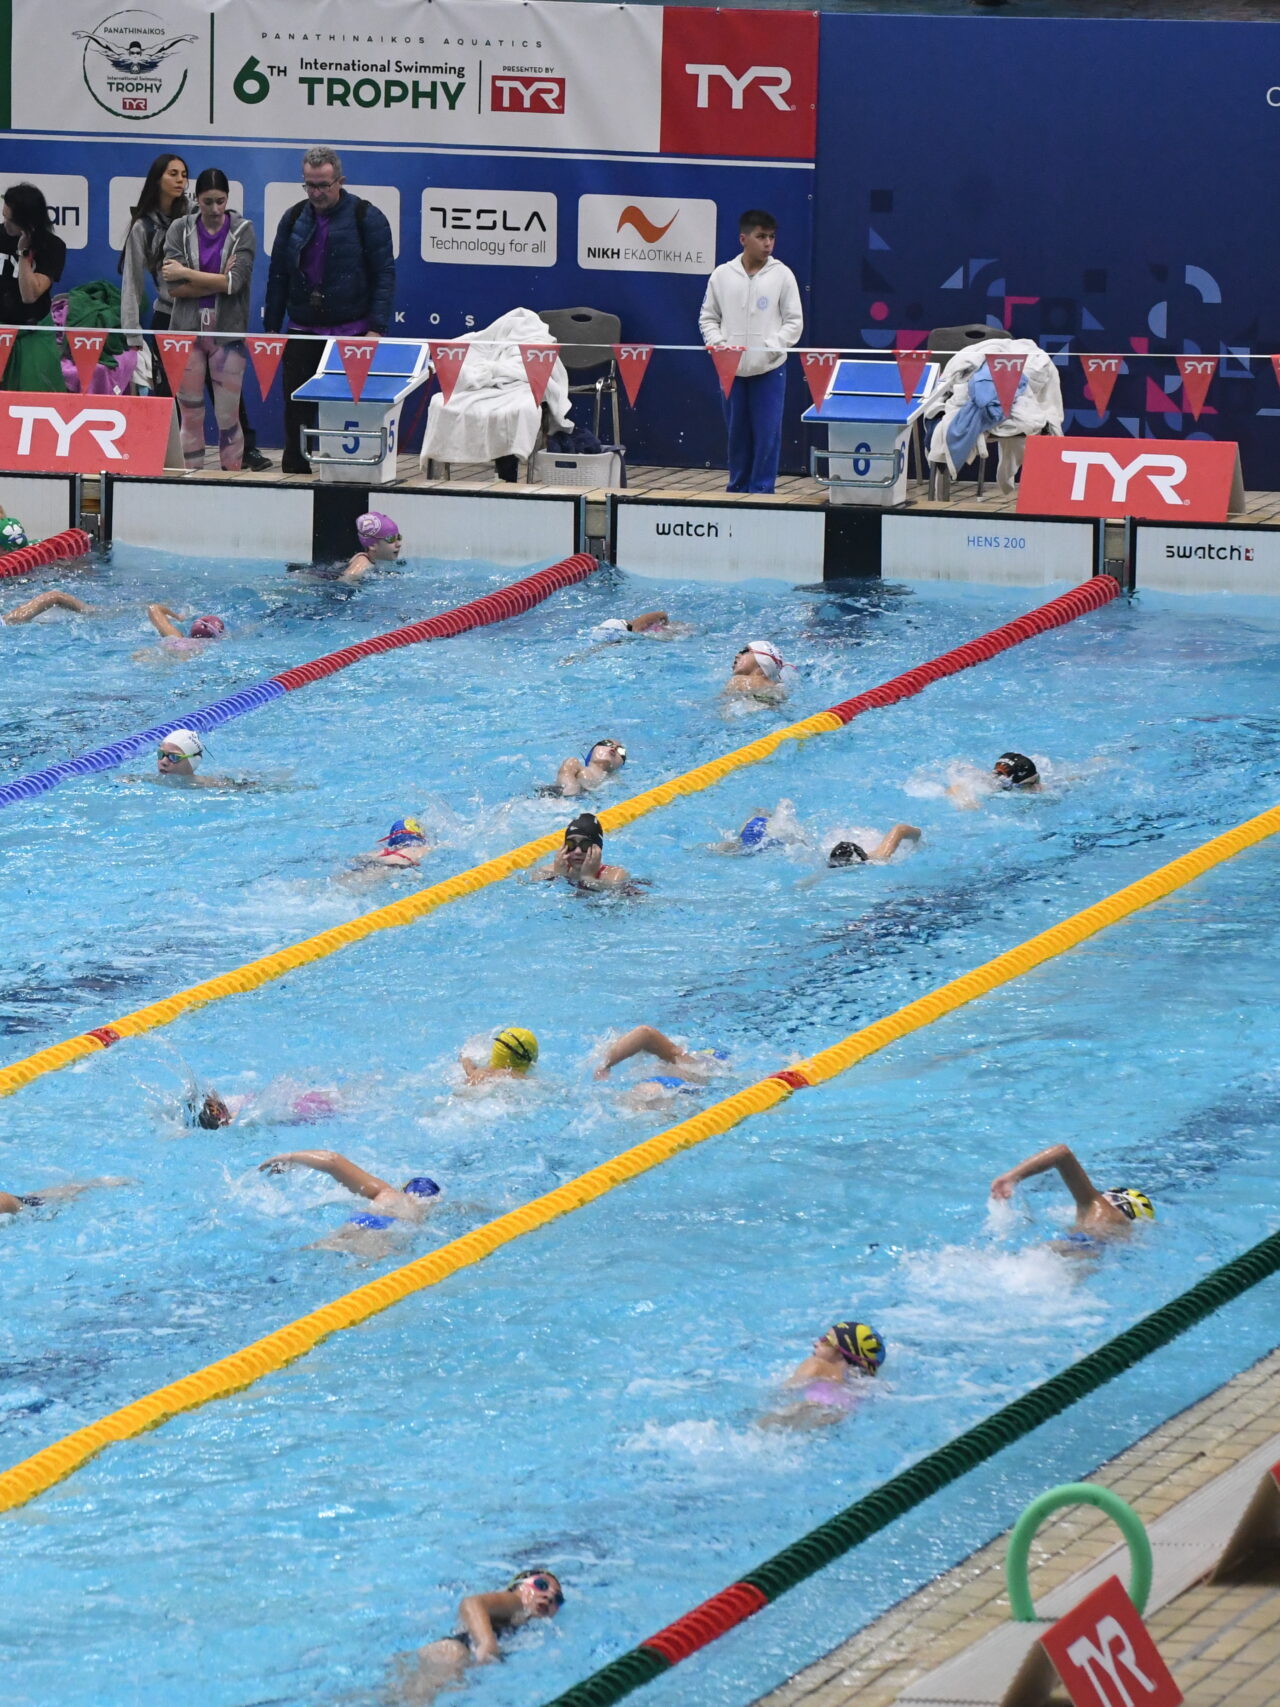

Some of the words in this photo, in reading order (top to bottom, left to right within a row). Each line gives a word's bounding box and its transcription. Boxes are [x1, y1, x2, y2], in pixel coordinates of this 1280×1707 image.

[103, 27, 165, 36] PANATHINAIKOS
[261, 32, 425, 44] PANATHINAIKOS
[443, 38, 542, 48] AQUATICS
[300, 57, 391, 73] International
[394, 60, 465, 79] Swimming
[502, 65, 543, 74] PRESENTED
[107, 82, 162, 93] TROPHY
[298, 77, 466, 110] TROPHY
[495, 80, 560, 110] TYR
[685, 63, 793, 111] TYR
[124, 99, 145, 109] TYR
[430, 207, 546, 232] TESLA
[430, 236, 505, 256] Technology
[509, 239, 528, 253] for
[532, 240, 546, 253] all
[587, 247, 620, 260] ΝΙΚΗ
[9, 405, 127, 459] TYR
[342, 421, 360, 454] 5
[388, 420, 396, 452] 5
[1061, 450, 1187, 505] TYR
[967, 536, 1000, 548] HENS
[1004, 537, 1026, 549] 200
[1166, 544, 1241, 560] swatch
[1067, 1615, 1158, 1707] TYR
